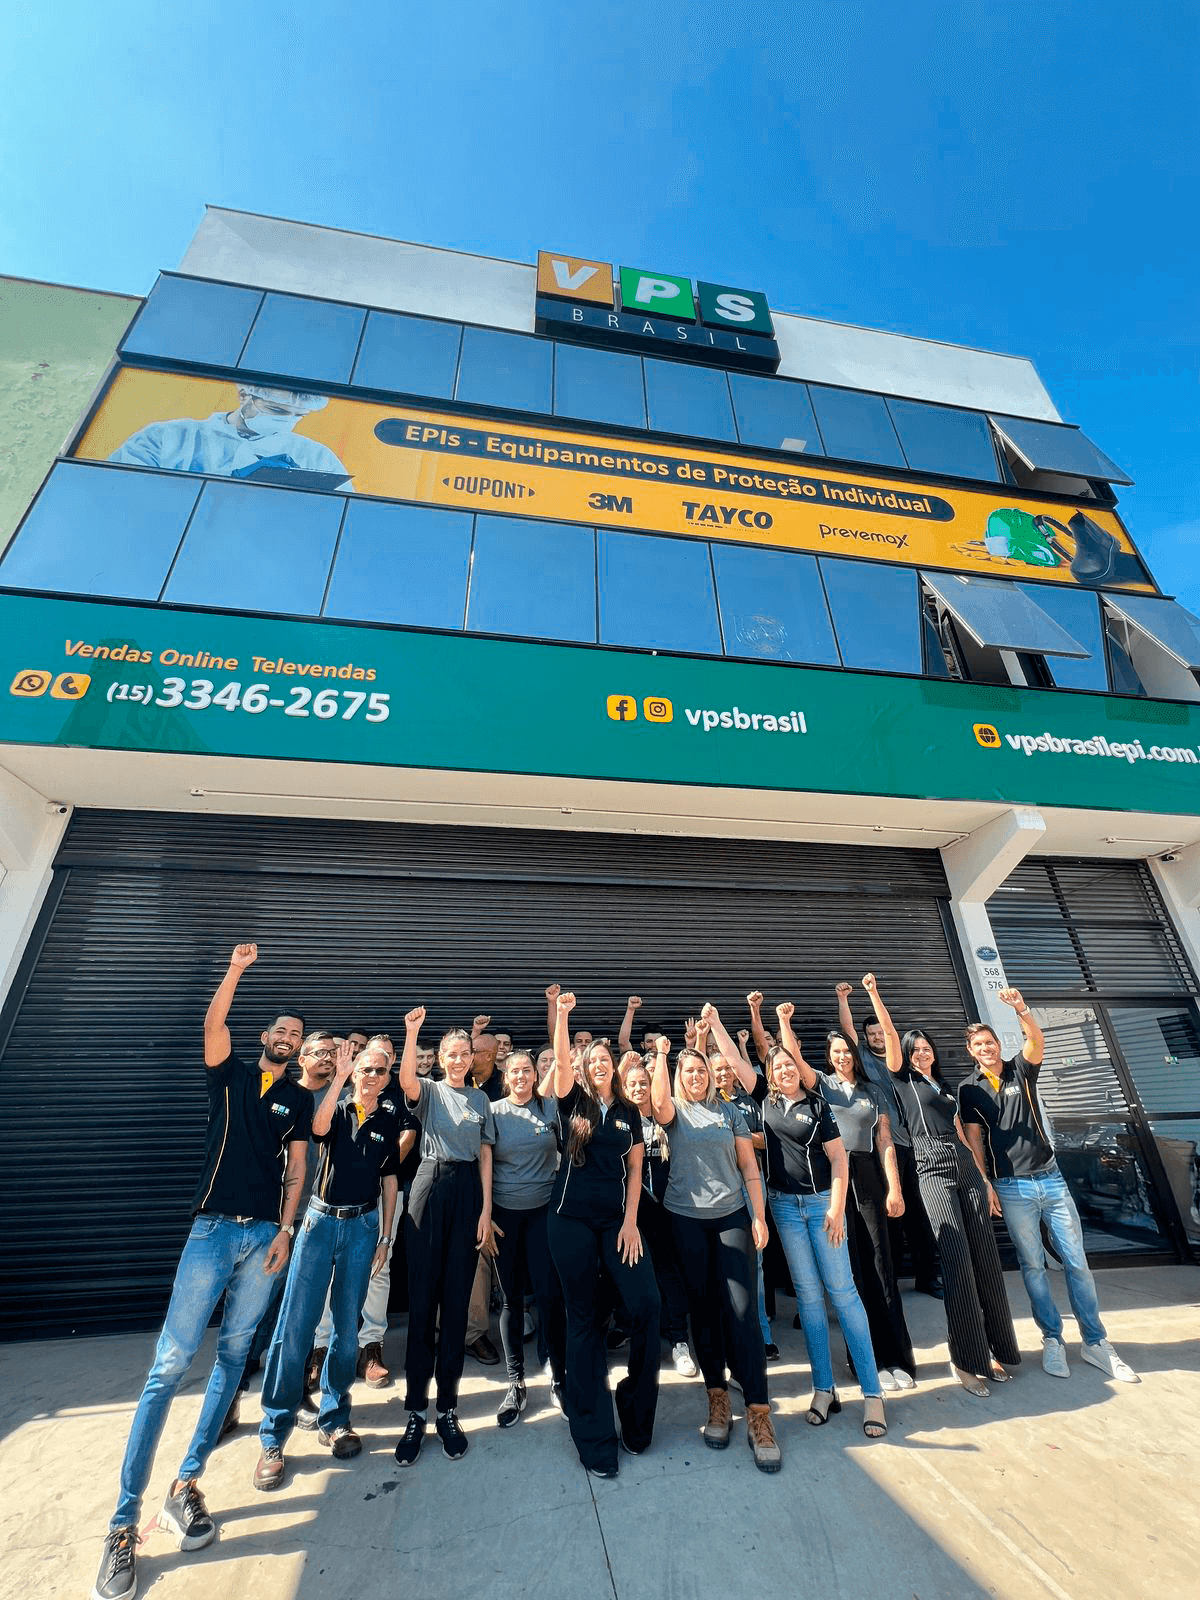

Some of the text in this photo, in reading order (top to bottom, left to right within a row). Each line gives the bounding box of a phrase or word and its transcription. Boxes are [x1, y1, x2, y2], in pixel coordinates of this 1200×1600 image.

[573, 308, 747, 351] BRASIL
[404, 425, 461, 447] EPIs
[486, 436, 670, 476] Equipamentos
[676, 463, 706, 481] de
[713, 467, 817, 498] Proteção
[822, 483, 932, 514] Individual
[453, 476, 526, 498] DUPONT
[587, 492, 633, 514] 3M
[682, 501, 774, 529] TAYCO
[65, 639, 377, 681] Vendas Online Televendas
[106, 676, 391, 723] (15) 3346-2675
[684, 706, 807, 733] vpsbrasil
[1005, 732, 1200, 764] vpsbrasilepi.com
[984, 967, 1000, 976] 568
[987, 981, 1004, 990] 576
